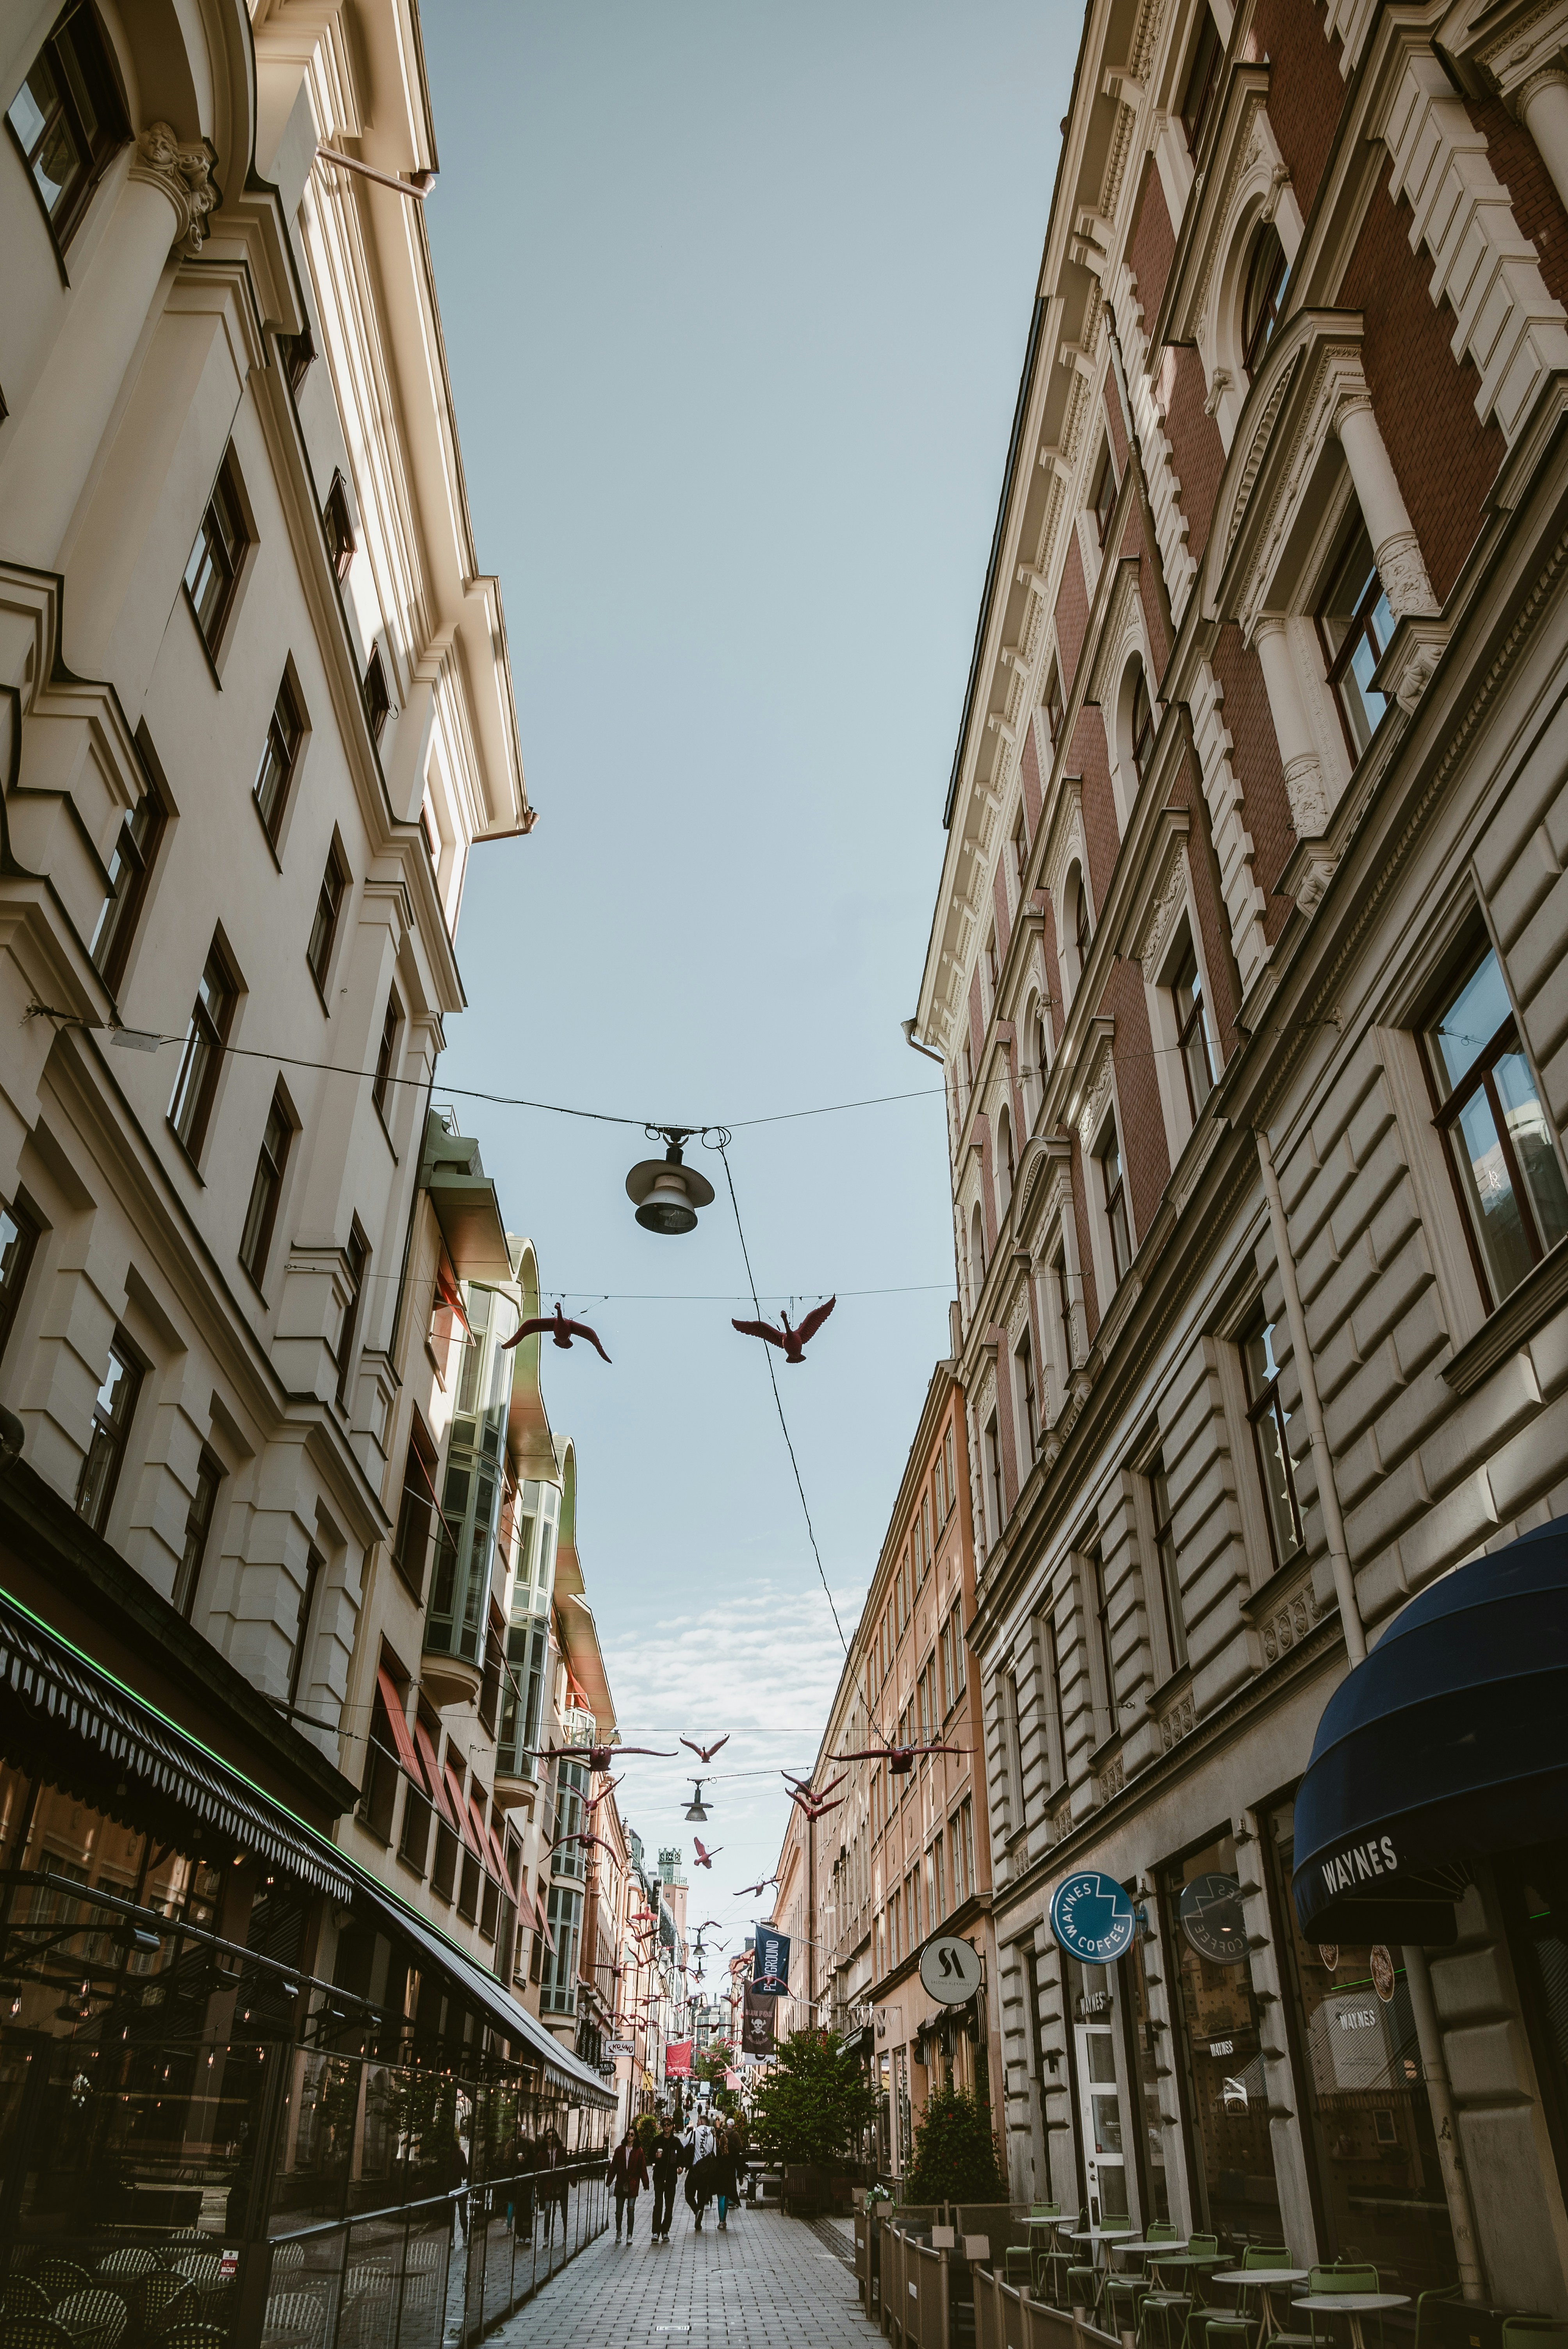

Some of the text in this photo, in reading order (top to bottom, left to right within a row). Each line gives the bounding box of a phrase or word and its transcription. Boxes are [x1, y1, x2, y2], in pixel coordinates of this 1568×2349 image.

[1322, 1836, 1397, 1894] WAYNES
[1062, 1883, 1124, 1952] WAYNES COFFEE
[764, 1940, 779, 1991] PLYGROUND
[1080, 1991, 1103, 2016] WAYNES
[1339, 2010, 1376, 2030] WAYNES
[607, 2043, 634, 2054] SKO UNO
[1210, 2041, 1233, 2057] WAYNES
